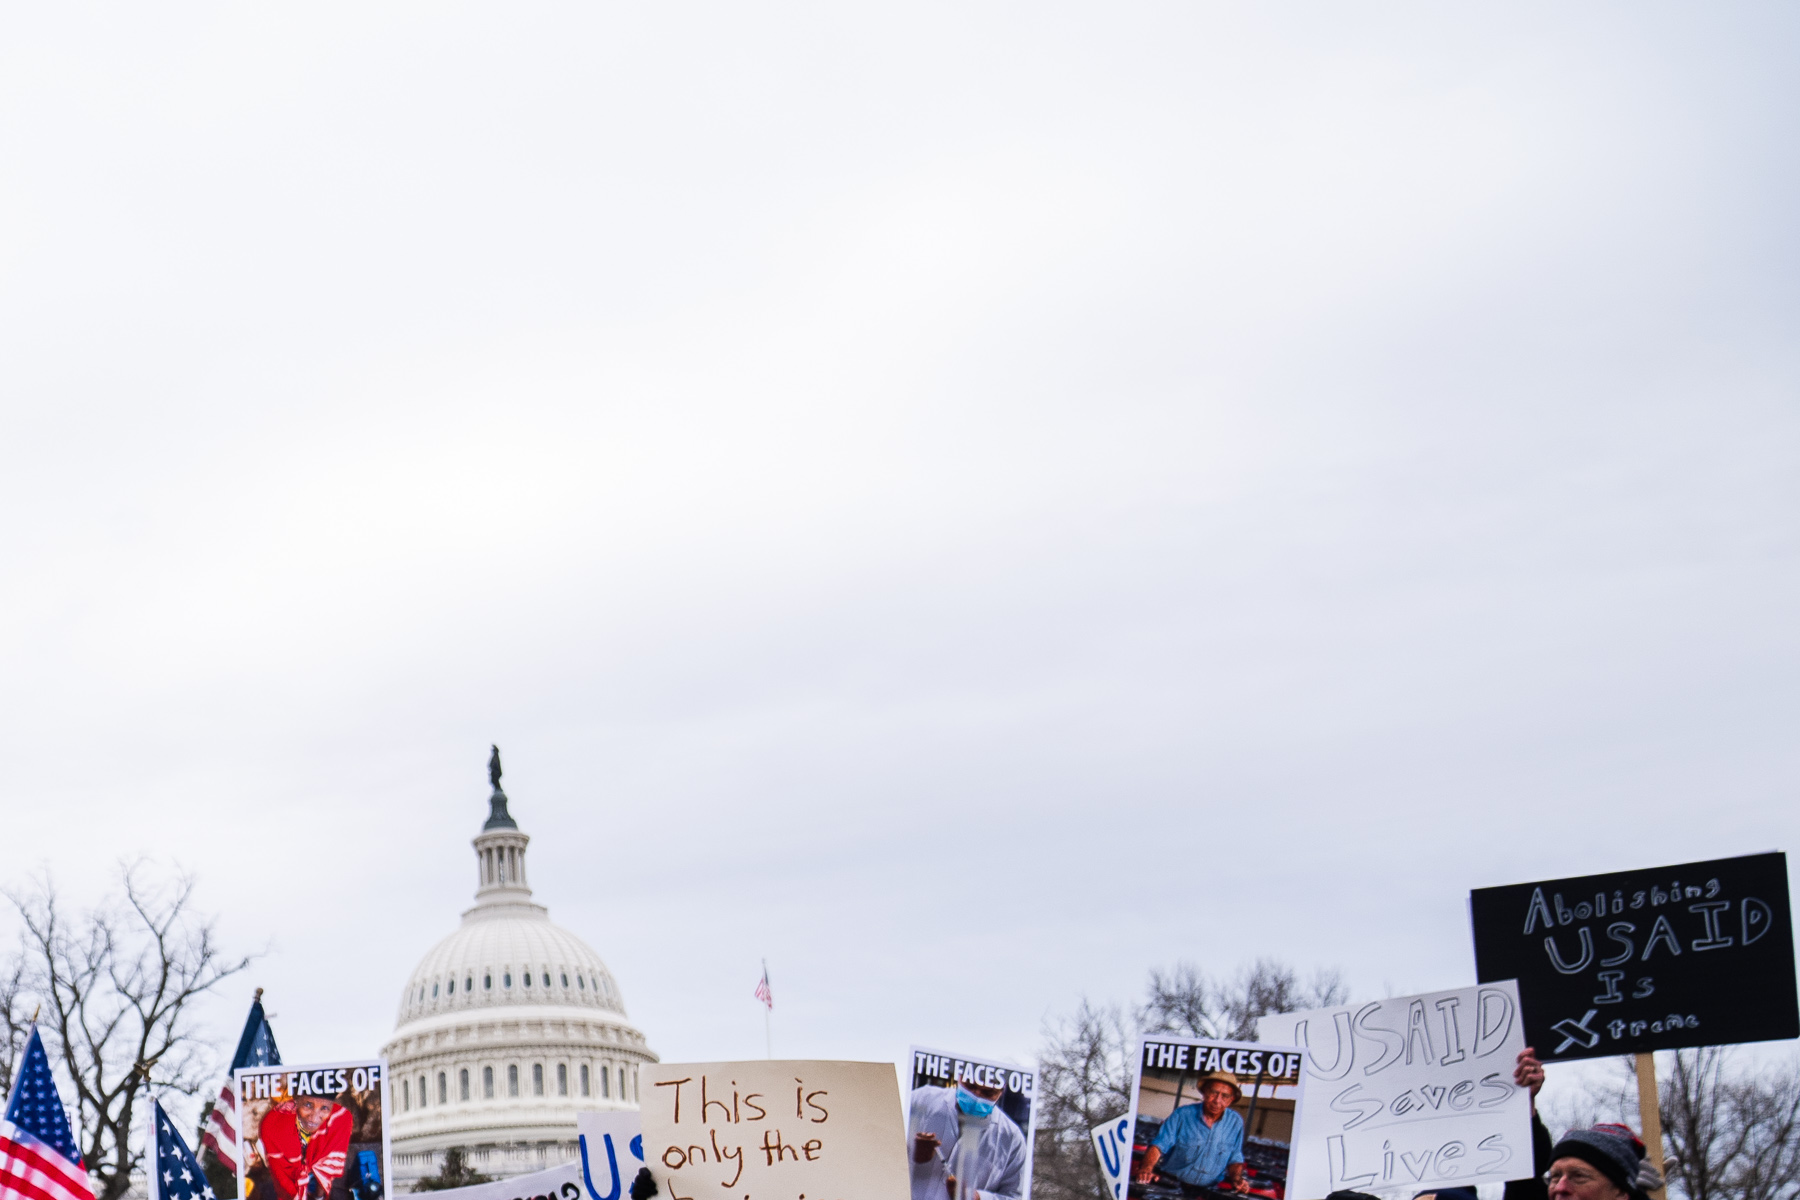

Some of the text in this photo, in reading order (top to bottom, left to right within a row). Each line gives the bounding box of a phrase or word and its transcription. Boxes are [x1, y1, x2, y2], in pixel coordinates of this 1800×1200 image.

[1524, 878, 1721, 935] Abolishing
[1544, 897, 1772, 974] USAID
[1145, 1043, 1299, 1079] THE FACES OF
[1295, 987, 1514, 1081] USAID
[241, 1068, 381, 1100] THE FACES OF
[915, 1052, 950, 1079] THE
[954, 1060, 1006, 1089] FACES
[654, 1075, 829, 1124] This is
[1329, 1071, 1514, 1130] Saves
[662, 1129, 822, 1188] only the
[1327, 1133, 1512, 1191] Lives
